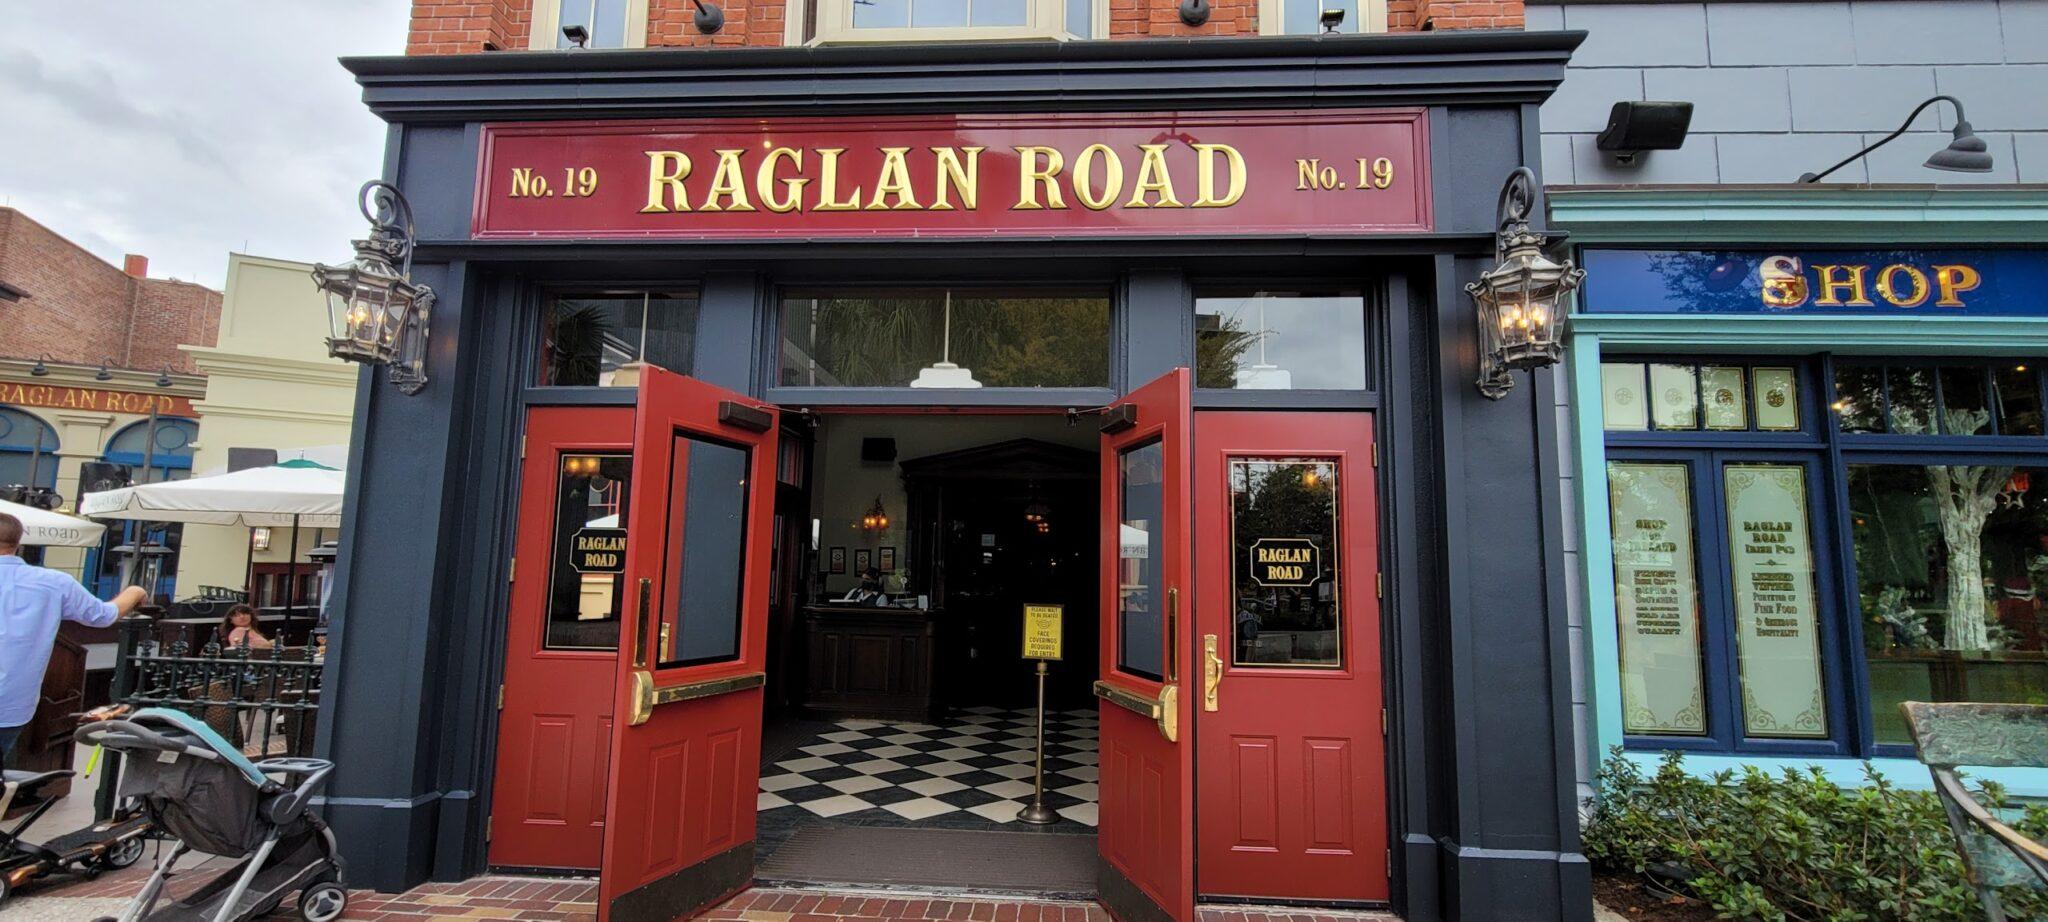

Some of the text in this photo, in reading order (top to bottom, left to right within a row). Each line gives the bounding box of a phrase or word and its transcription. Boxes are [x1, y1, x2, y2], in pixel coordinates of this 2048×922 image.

[640, 143, 1248, 214] RAGLAN ROAD
[1295, 157, 1394, 191] No. 19
[508, 166, 597, 198] No. 19
[1759, 255, 1981, 309] SHOP
[0, 383, 174, 412] RAGLAN ROAD
[1743, 521, 1792, 532] RAGLAN
[578, 536, 626, 550] RAGLAN
[1753, 533, 1786, 543] ROAD
[584, 553, 617, 567] ROAD
[1258, 547, 1311, 562] RAGLAN
[1267, 565, 1303, 580] ROAD
